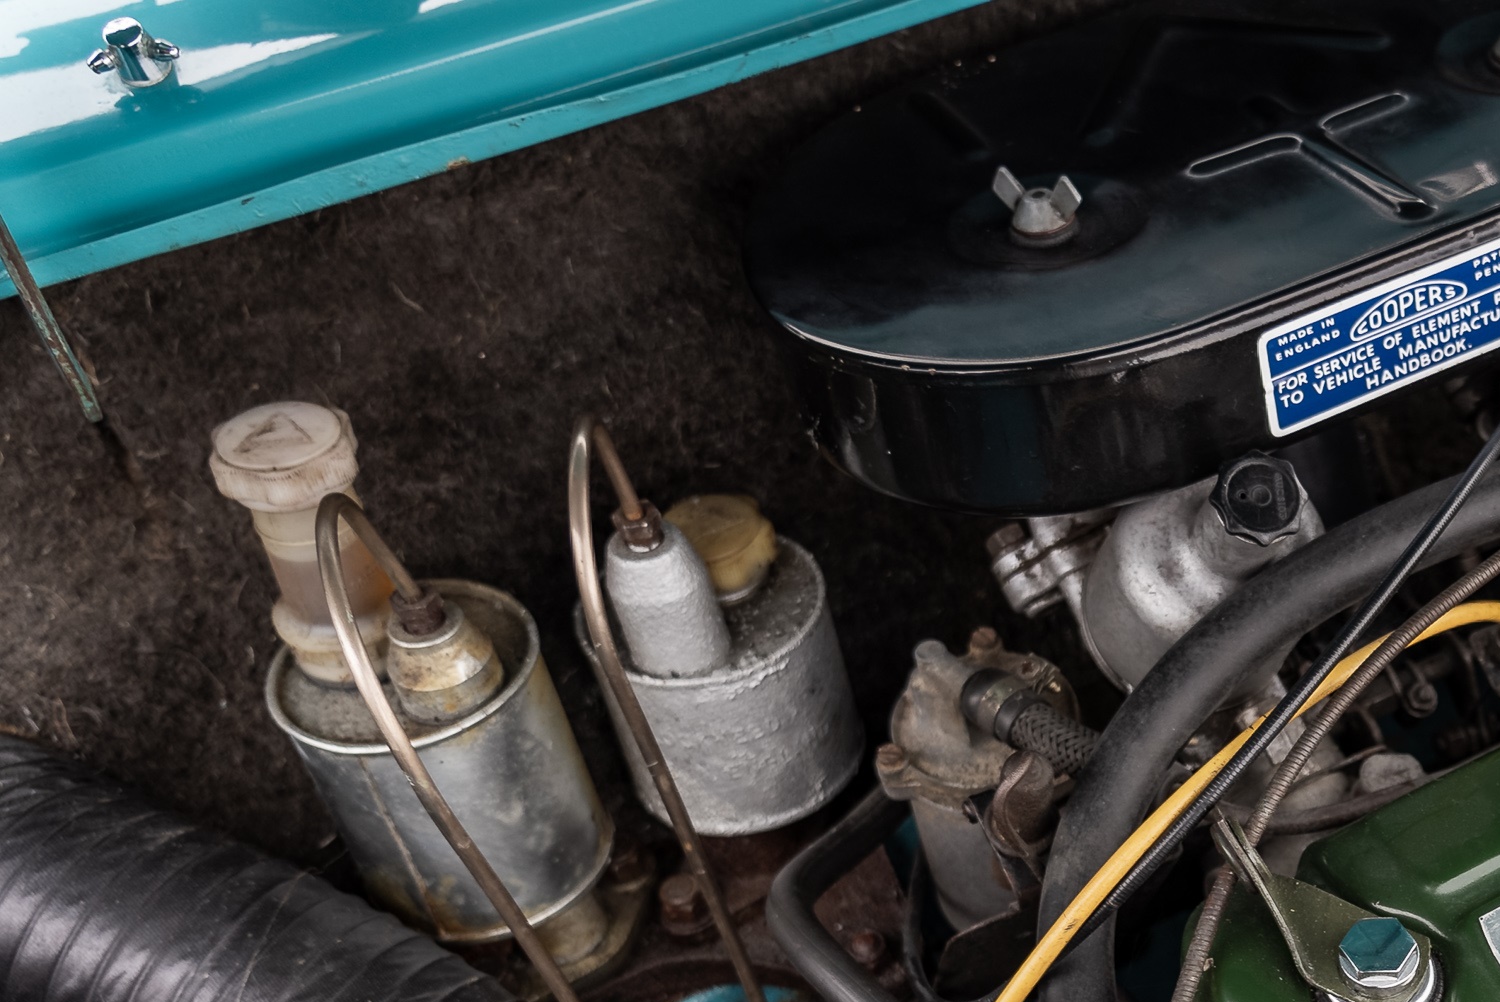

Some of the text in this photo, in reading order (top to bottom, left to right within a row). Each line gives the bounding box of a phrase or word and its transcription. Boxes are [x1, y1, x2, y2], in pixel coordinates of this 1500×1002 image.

[1275, 330, 1340, 362] ENGLAND
[1277, 318, 1335, 347] MADE IN
[1278, 374, 1308, 395] FOR
[1314, 345, 1375, 379] SERVICE
[1383, 334, 1403, 349] OF
[1412, 301, 1480, 339] ELEMENT
[1281, 391, 1304, 409] TO
[1313, 359, 1382, 394] VEHICLE
[1366, 338, 1473, 390] HANDBOOK.
